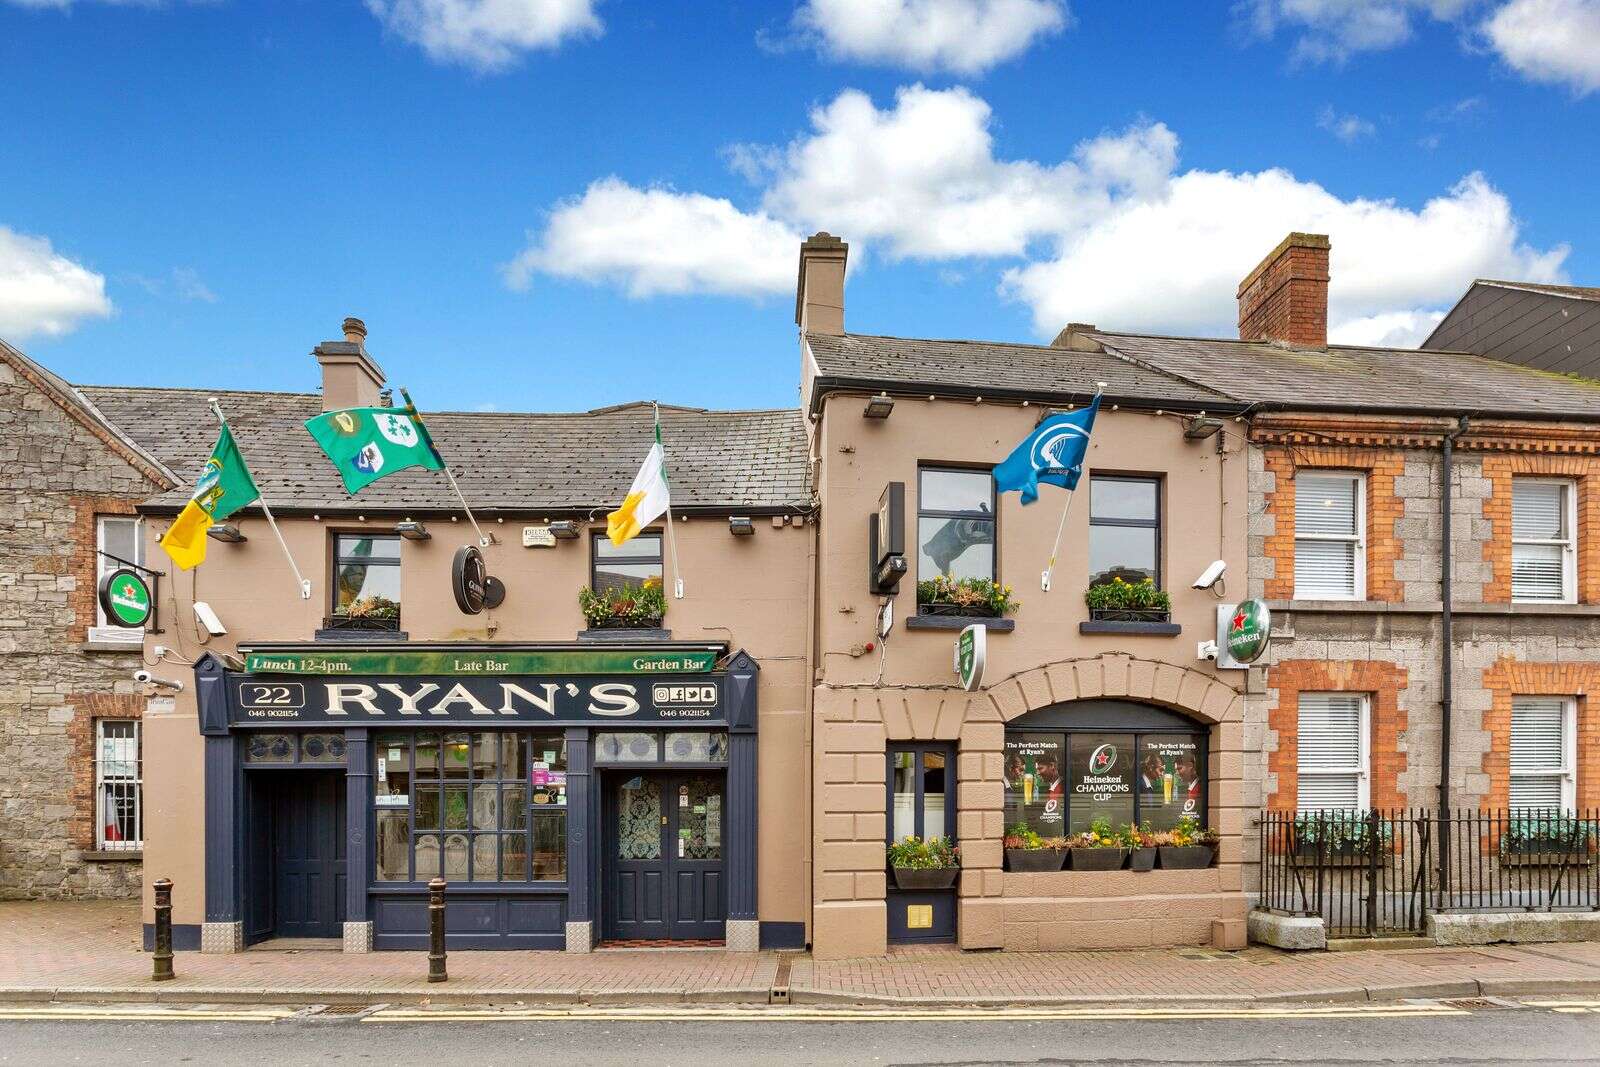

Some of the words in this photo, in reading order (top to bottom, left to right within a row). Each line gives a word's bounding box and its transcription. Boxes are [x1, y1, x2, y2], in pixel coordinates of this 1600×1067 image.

[252, 658, 296, 670] Lunch
[454, 660, 482, 671] Late
[486, 660, 509, 671] Bar
[633, 658, 679, 670] Garden
[683, 658, 706, 670] Bar
[253, 686, 292, 705] 22
[323, 682, 640, 716] RYAN'S
[1083, 775, 1122, 784] Heineken
[1076, 784, 1130, 793] CHAMPIONS
[1093, 793, 1112, 801] CUP
